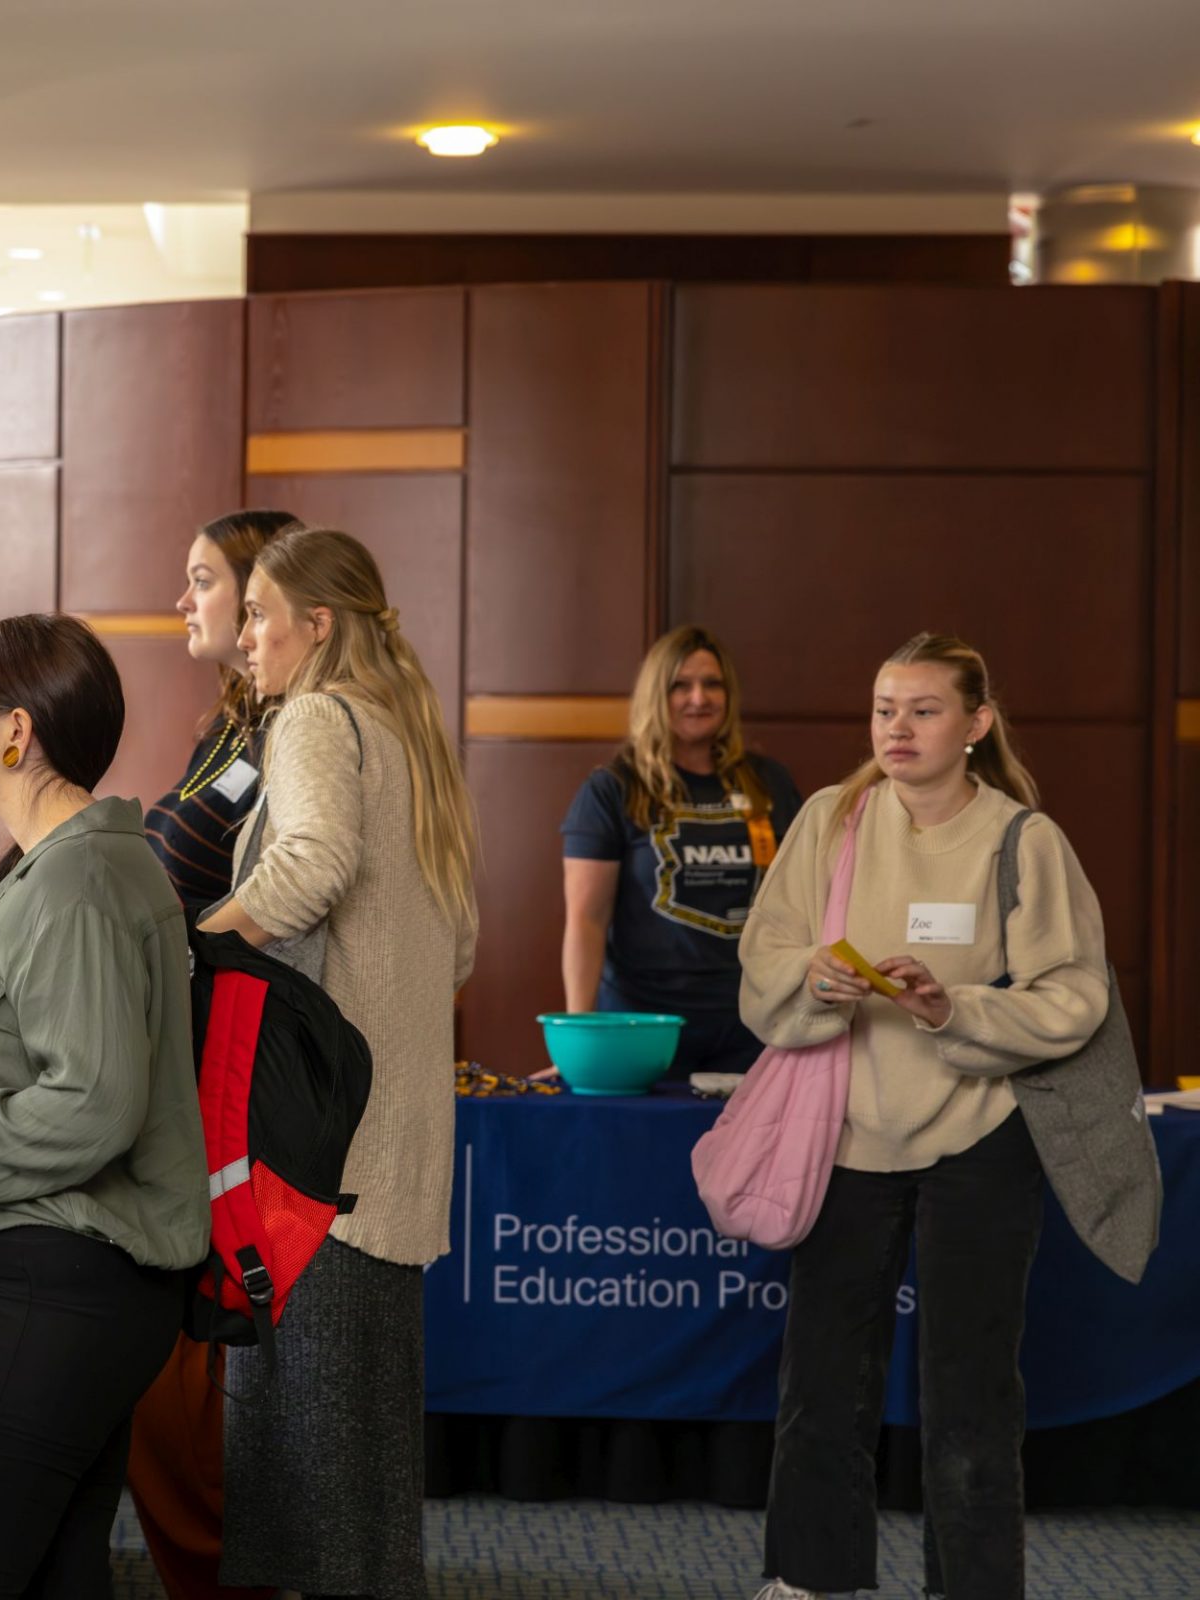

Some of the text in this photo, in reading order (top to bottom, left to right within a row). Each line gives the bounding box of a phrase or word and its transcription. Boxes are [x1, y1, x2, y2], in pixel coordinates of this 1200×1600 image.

[683, 845, 752, 864] NAU
[911, 917, 933, 930] Zoe
[494, 1213, 749, 1258] Professional
[494, 1266, 916, 1315] Education Pros
